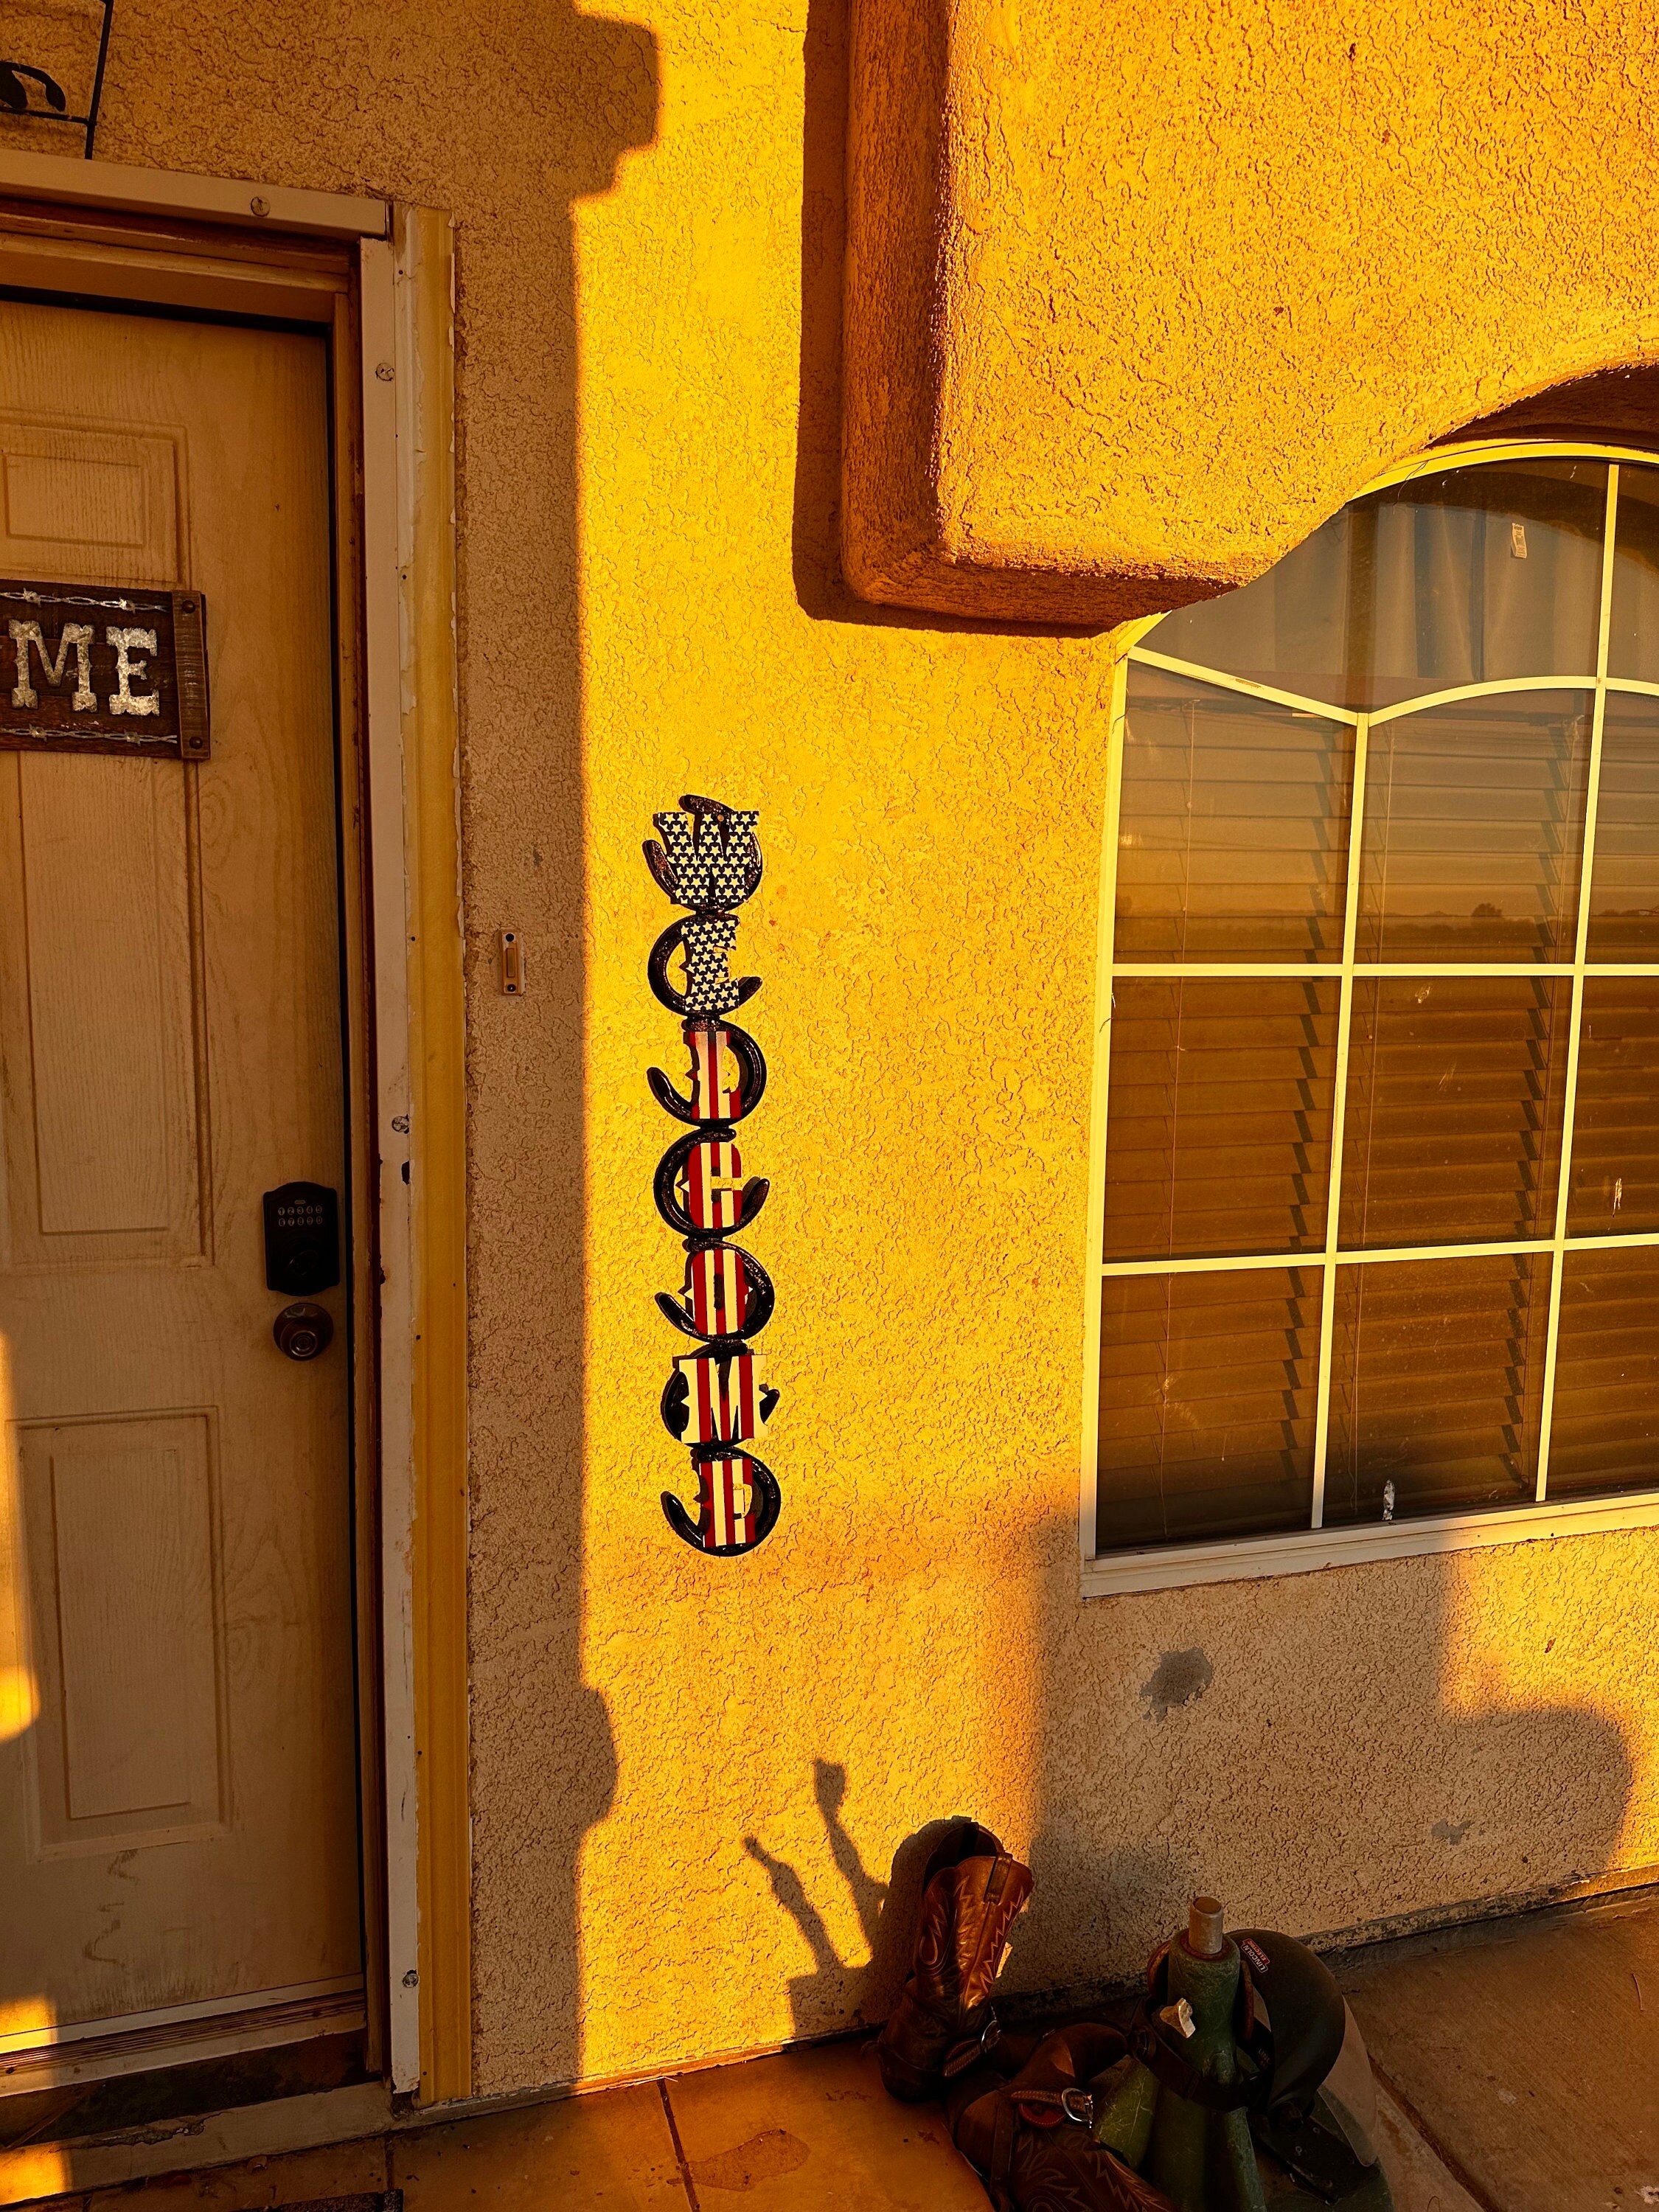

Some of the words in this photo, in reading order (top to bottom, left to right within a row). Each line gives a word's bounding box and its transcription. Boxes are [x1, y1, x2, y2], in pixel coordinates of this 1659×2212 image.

[655, 810, 769, 1548] WELCOME
[1242, 1945, 1266, 1970] LINCOLN
[1247, 1940, 1267, 1961] ELECTRIC
